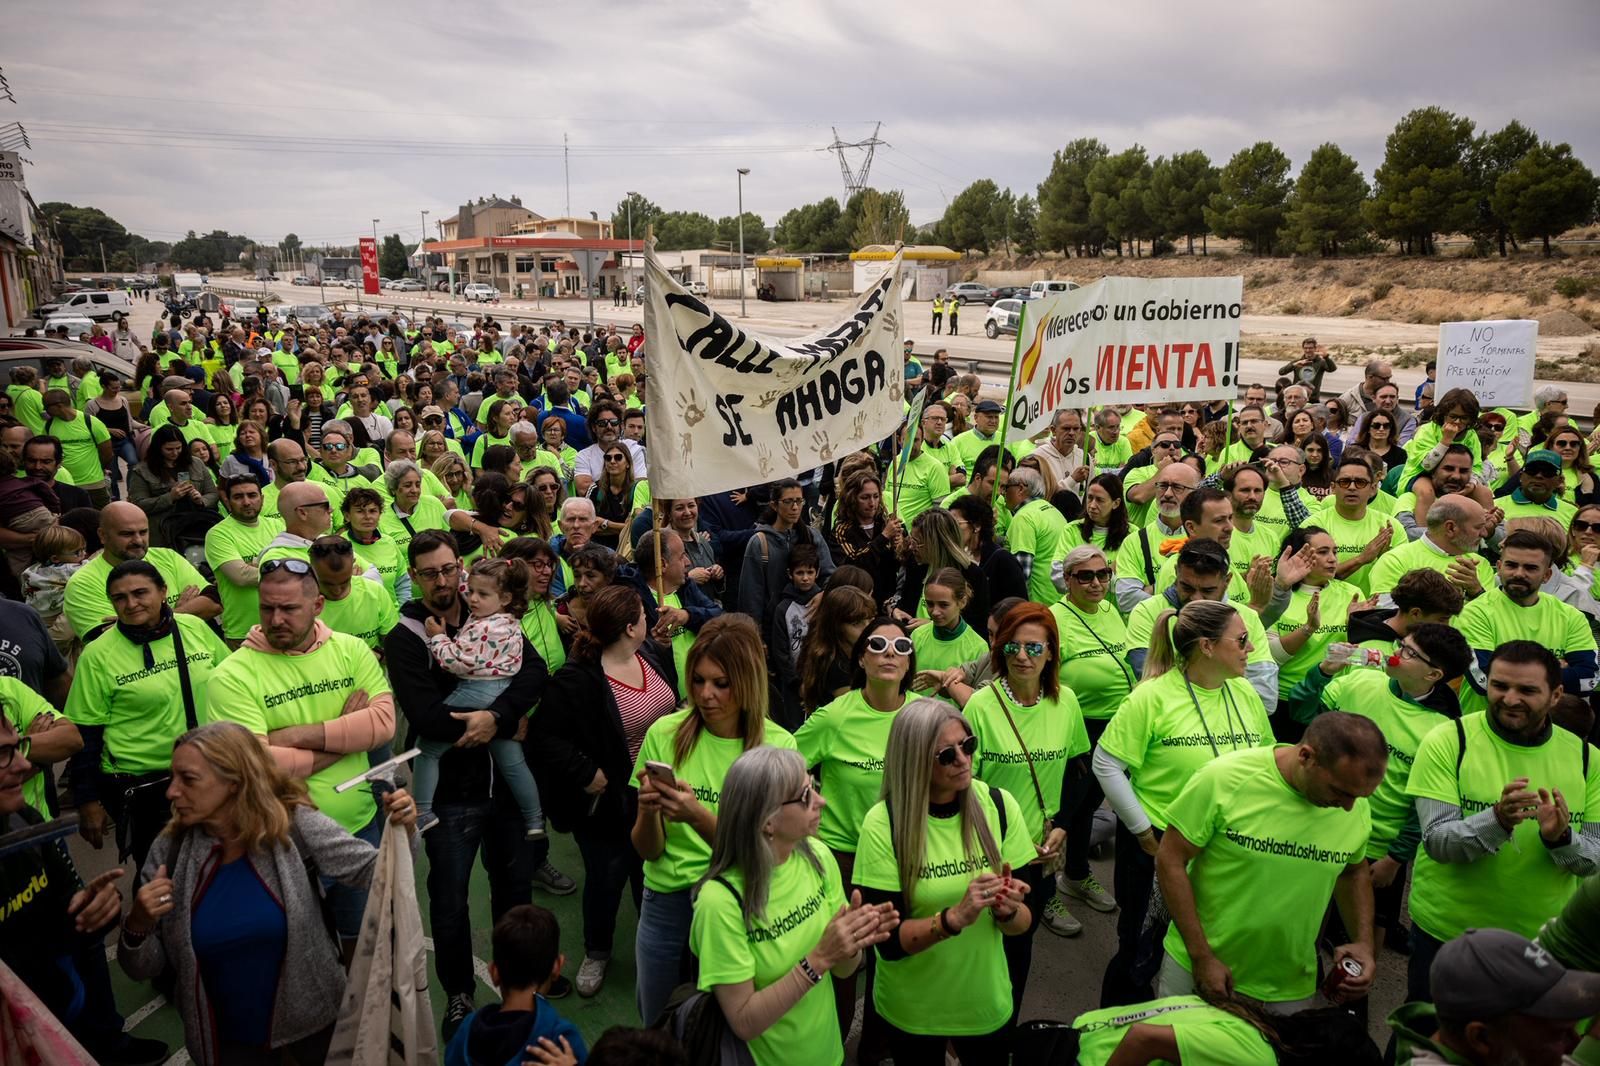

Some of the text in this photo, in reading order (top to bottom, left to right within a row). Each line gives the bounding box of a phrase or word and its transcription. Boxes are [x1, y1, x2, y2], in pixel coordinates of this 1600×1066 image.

[1113, 303, 1137, 321] un
[1141, 299, 1241, 321] Gobierno
[1470, 326, 1494, 342] NO
[1446, 344, 1472, 357] MÁS
[716, 350, 885, 446] SE AHOGA
[1011, 394, 1039, 431] Que
[1225, 827, 1354, 864] EstamosHastaLosHuerva.co
